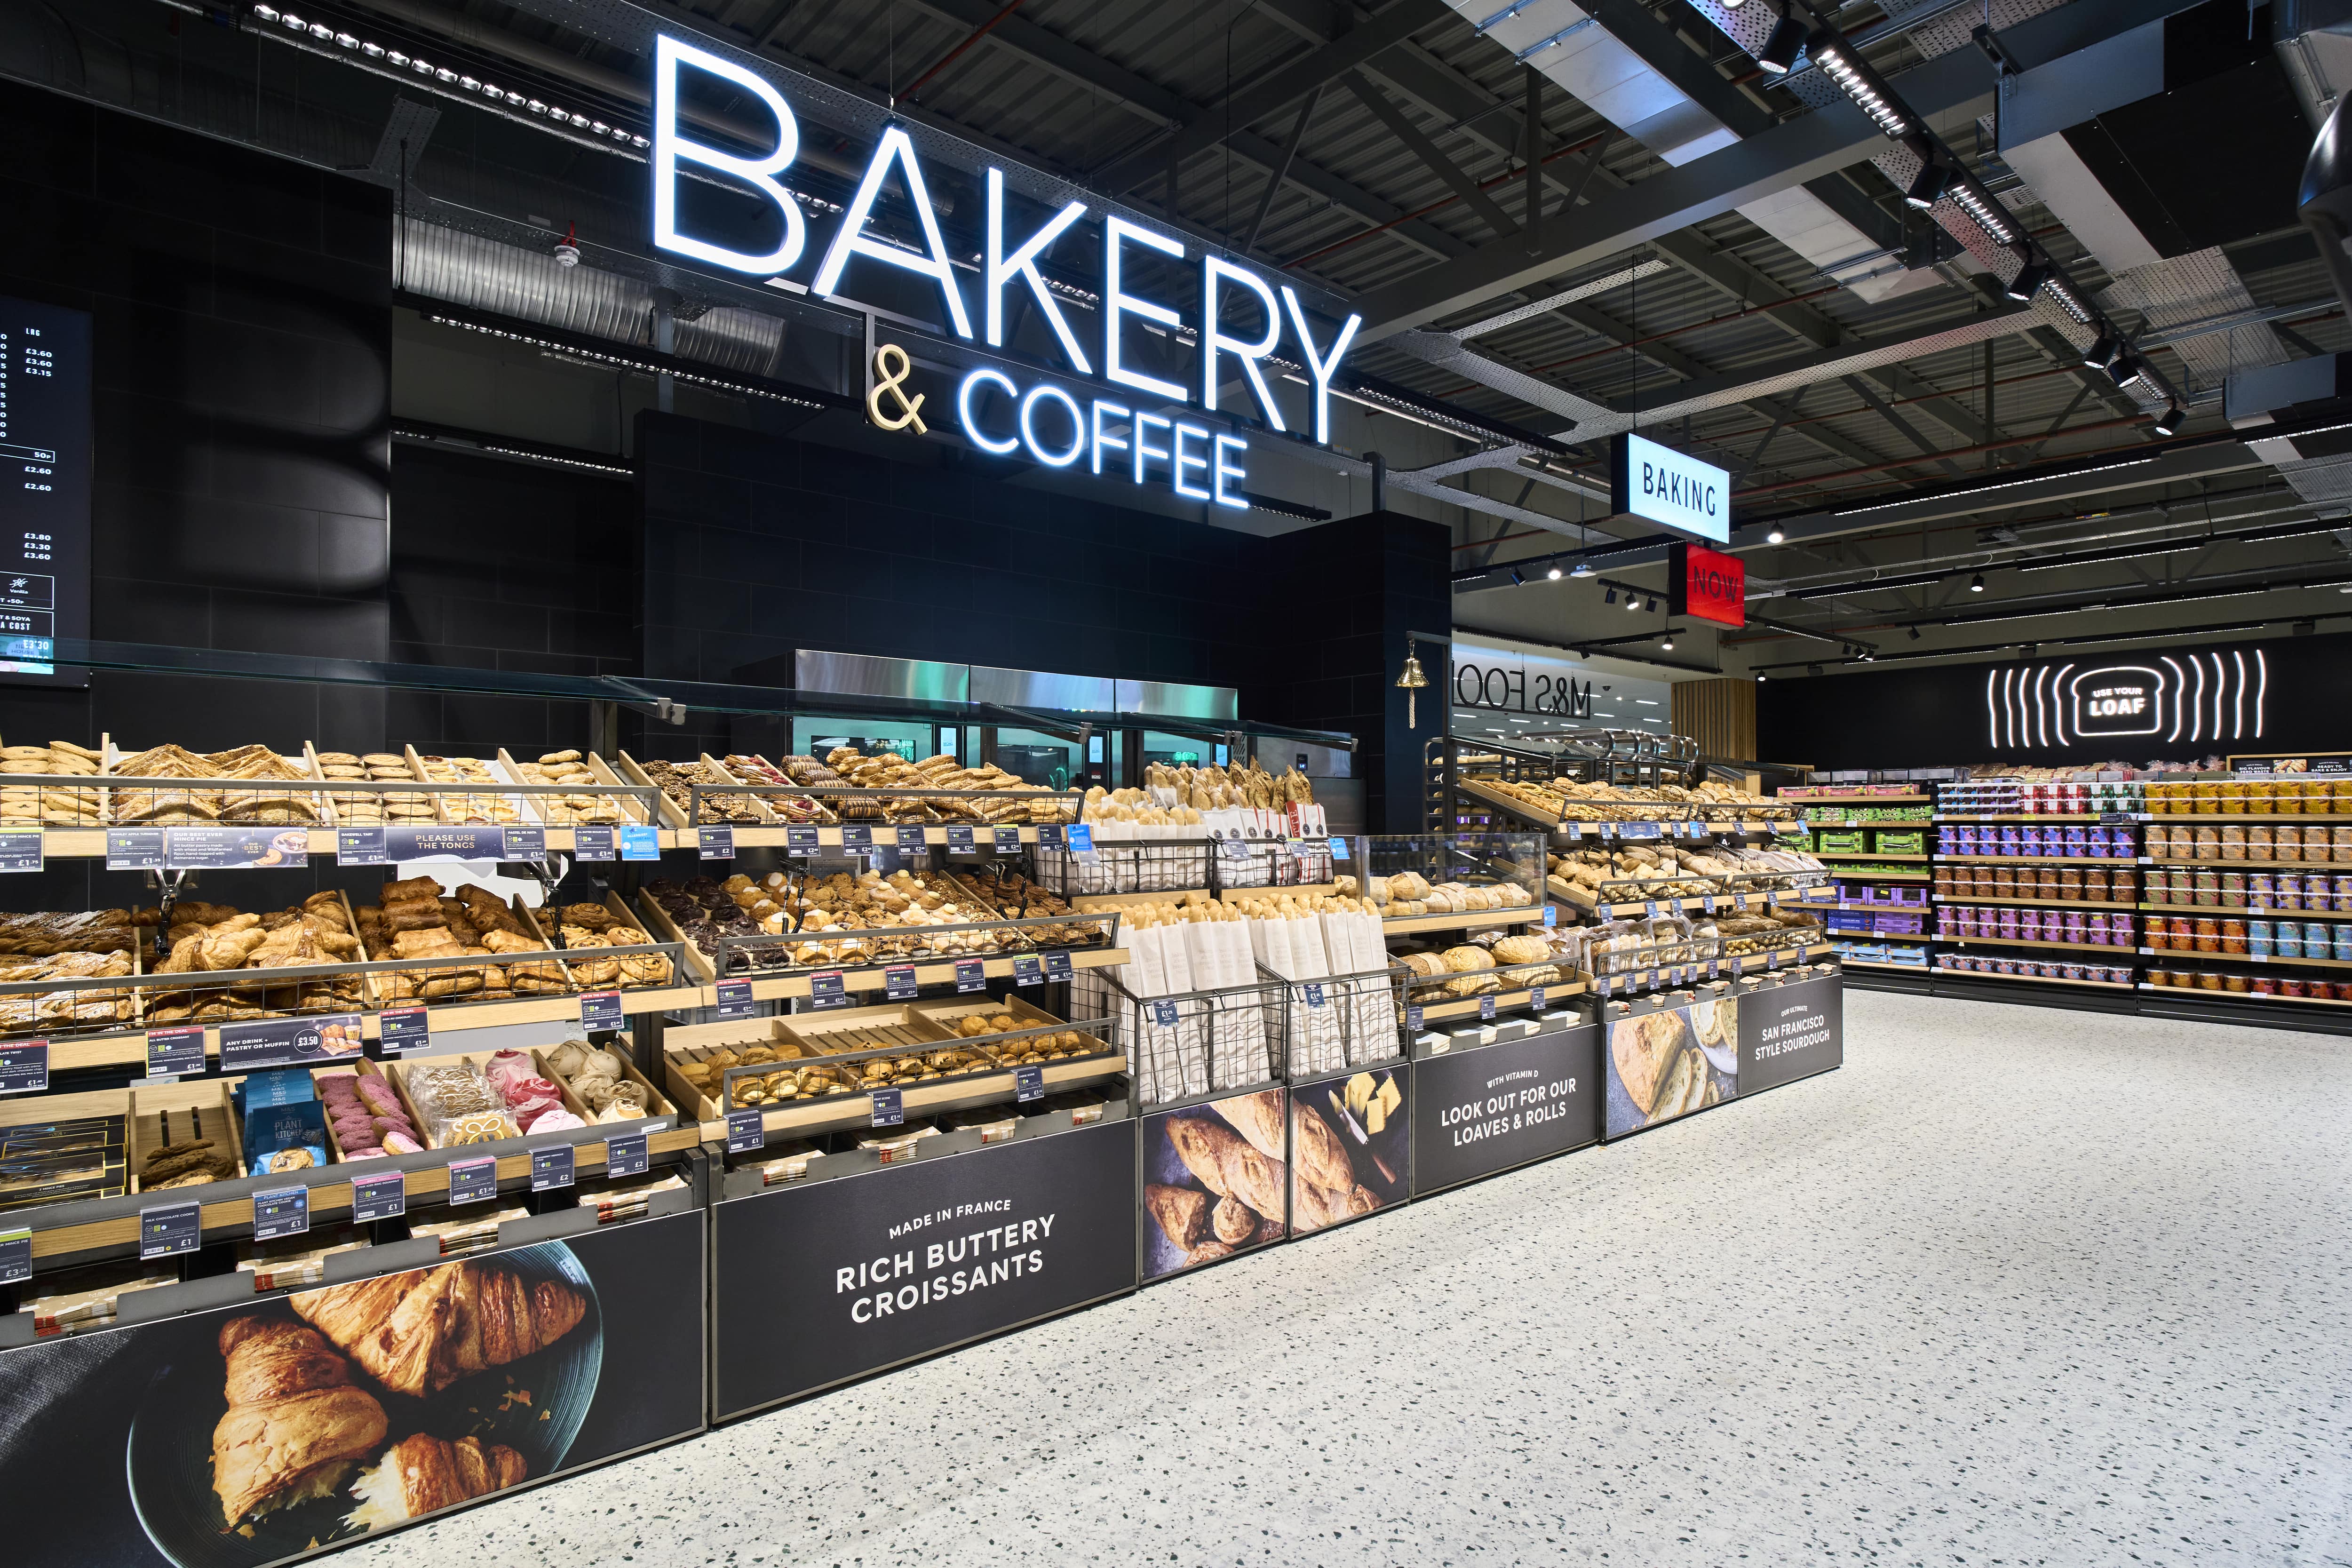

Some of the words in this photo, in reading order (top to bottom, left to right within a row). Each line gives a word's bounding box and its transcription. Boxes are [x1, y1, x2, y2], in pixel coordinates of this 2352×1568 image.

[654, 33, 1361, 443] BAKERY
[26, 328, 40, 336] LRG
[25, 348, 52, 358] £3.60
[25, 358, 52, 367] £3.60
[25, 367, 52, 377] £3.15
[866, 343, 927, 435] &
[959, 369, 1249, 509] COFFEE
[24, 466, 52, 475] £2.60
[24, 483, 52, 492] £2.60
[1643, 462, 1716, 516] BAKING
[24, 533, 51, 541] £3.80
[24, 542, 50, 551] £3.30
[1694, 566, 1739, 603] NOW
[9, 622, 31, 631] COST
[2092, 689, 2113, 697] USE
[2090, 698, 2145, 716] LOAF
[1781, 1008, 1790, 1017] OUR
[1762, 1026, 1779, 1042] SAN
[1781, 1014, 1824, 1037] FRANCISCO
[297, 1036, 318, 1047] £3.50
[1755, 1042, 1780, 1061] STYLE
[1782, 1029, 1829, 1053] SOURDOUGH
[1486, 1075, 1504, 1089] WITH
[1505, 1070, 1533, 1082] VITAMIN
[1441, 1101, 1483, 1127] LOOK
[1486, 1092, 1516, 1114] OUT
[1520, 1085, 1546, 1106] FOR
[1549, 1077, 1576, 1098] OUR
[274, 1119, 302, 1130] PLANT
[1454, 1116, 1509, 1147] LOAVES
[1513, 1113, 1522, 1130] &
[1526, 1101, 1566, 1126] ROLLS
[275, 1129, 303, 1139] KITCHEN
[889, 1214, 933, 1239] MADE
[937, 1209, 952, 1223] IN
[956, 1199, 1012, 1217] FRANCE
[181, 1238, 191, 1247] £1
[836, 1250, 914, 1293] RICH
[927, 1213, 1056, 1269] BUTTERY
[6, 1268, 28, 1277] £3.25
[851, 1249, 1044, 1324] CROISSANTS
